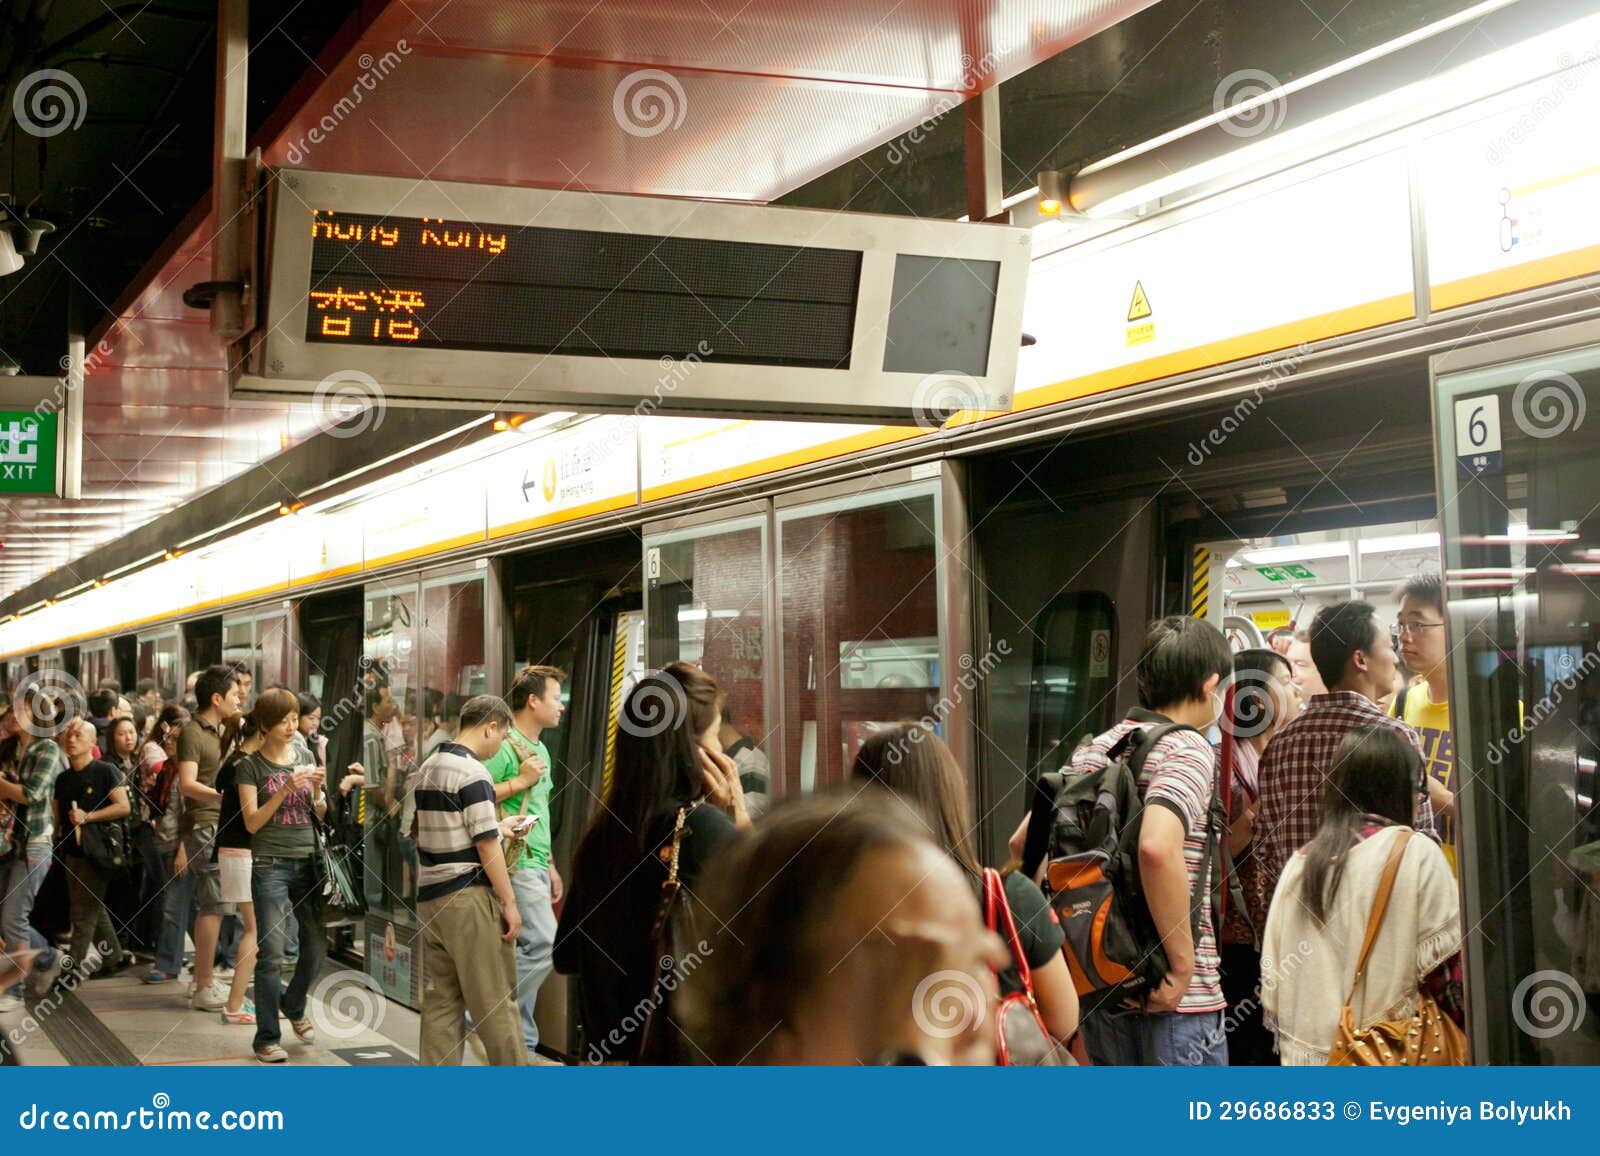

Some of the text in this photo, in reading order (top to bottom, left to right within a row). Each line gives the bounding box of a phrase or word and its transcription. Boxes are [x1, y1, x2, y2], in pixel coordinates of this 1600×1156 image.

[1468, 405, 1488, 447] 6
[2, 464, 38, 480] XIT
[650, 552, 658, 576] 6
